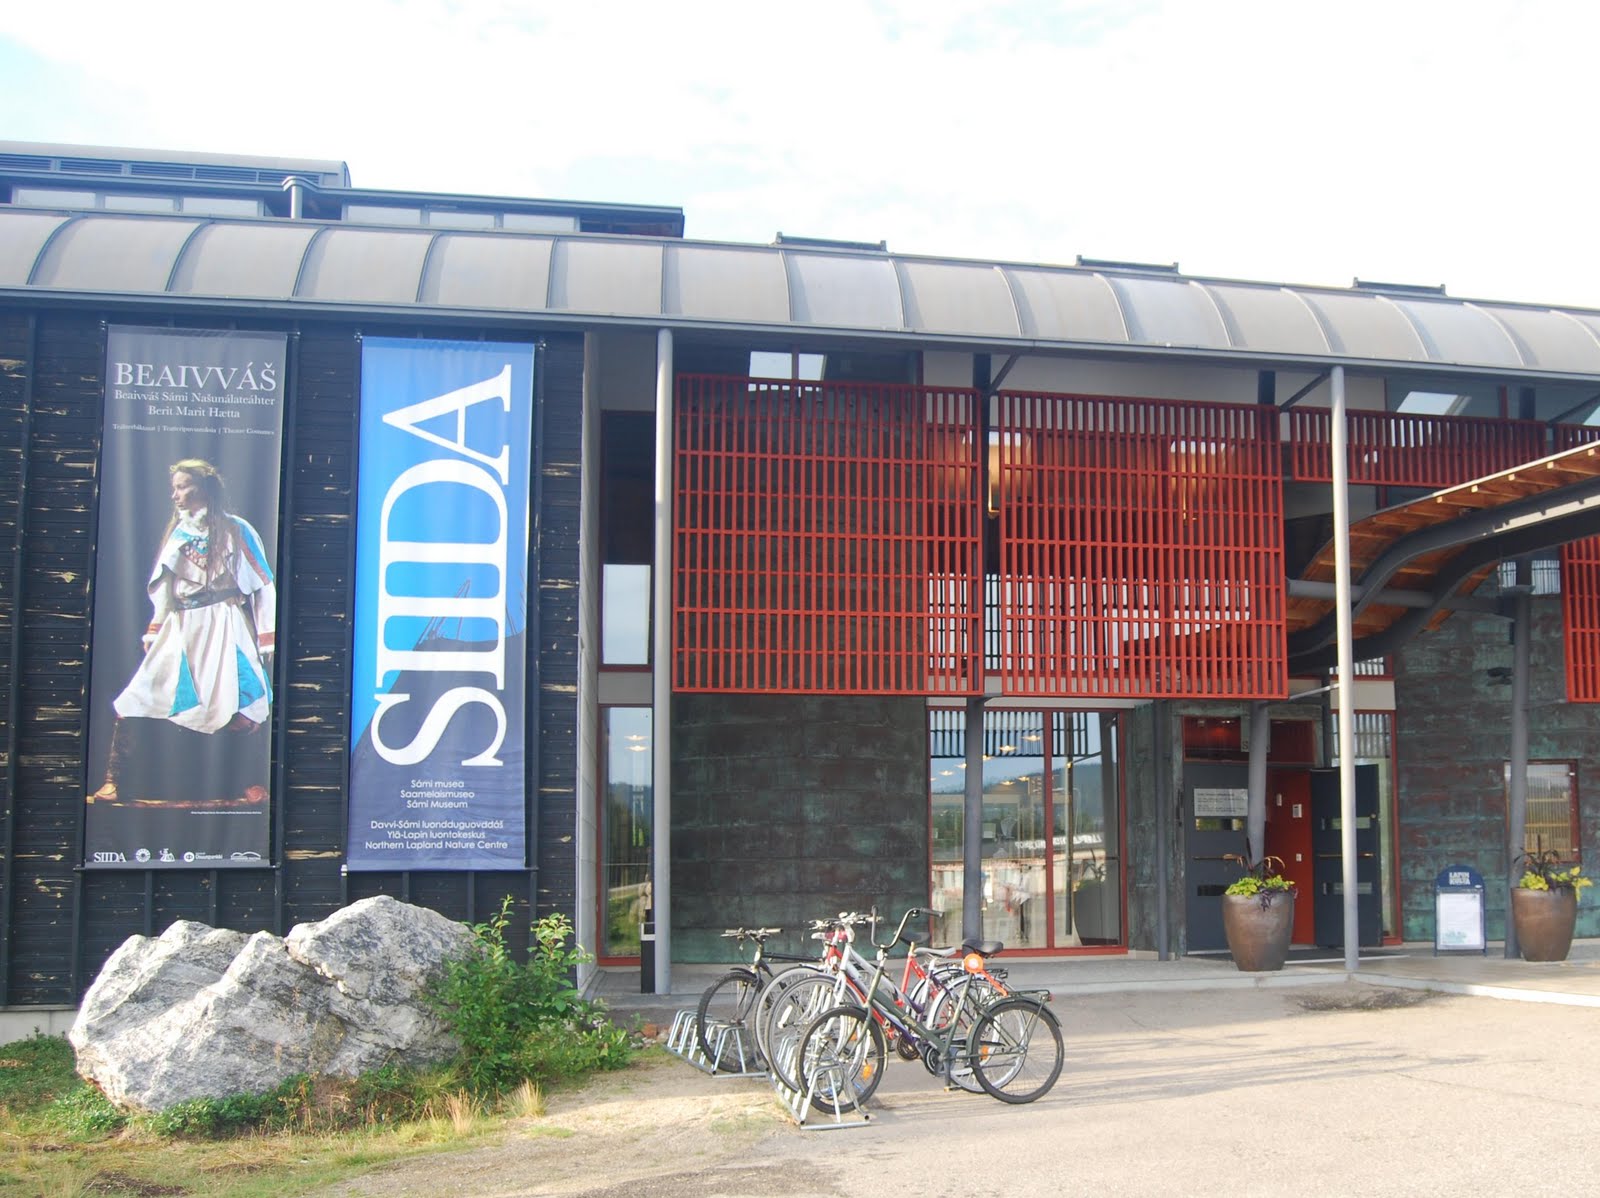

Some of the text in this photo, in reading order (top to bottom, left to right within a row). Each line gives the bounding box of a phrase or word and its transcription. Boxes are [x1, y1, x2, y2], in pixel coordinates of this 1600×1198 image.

[114, 362, 277, 391] BEAIVVÁŠ
[115, 390, 275, 406] Beaivváš Sámi Našunálateáhter
[148, 405, 240, 418] Berit Marit Hætta
[371, 364, 511, 767] SIIDA
[411, 779, 465, 789] Sámi musea
[400, 789, 475, 799] Saamelaismuseo
[406, 799, 468, 809] Sámi Museum
[370, 820, 421, 830] Davvi-Sámi
[387, 830, 486, 840] Ylä-Lapin luontokeskus
[365, 841, 508, 850] Northern Lapland Nature Centre
[93, 852, 127, 863] SIIDA
